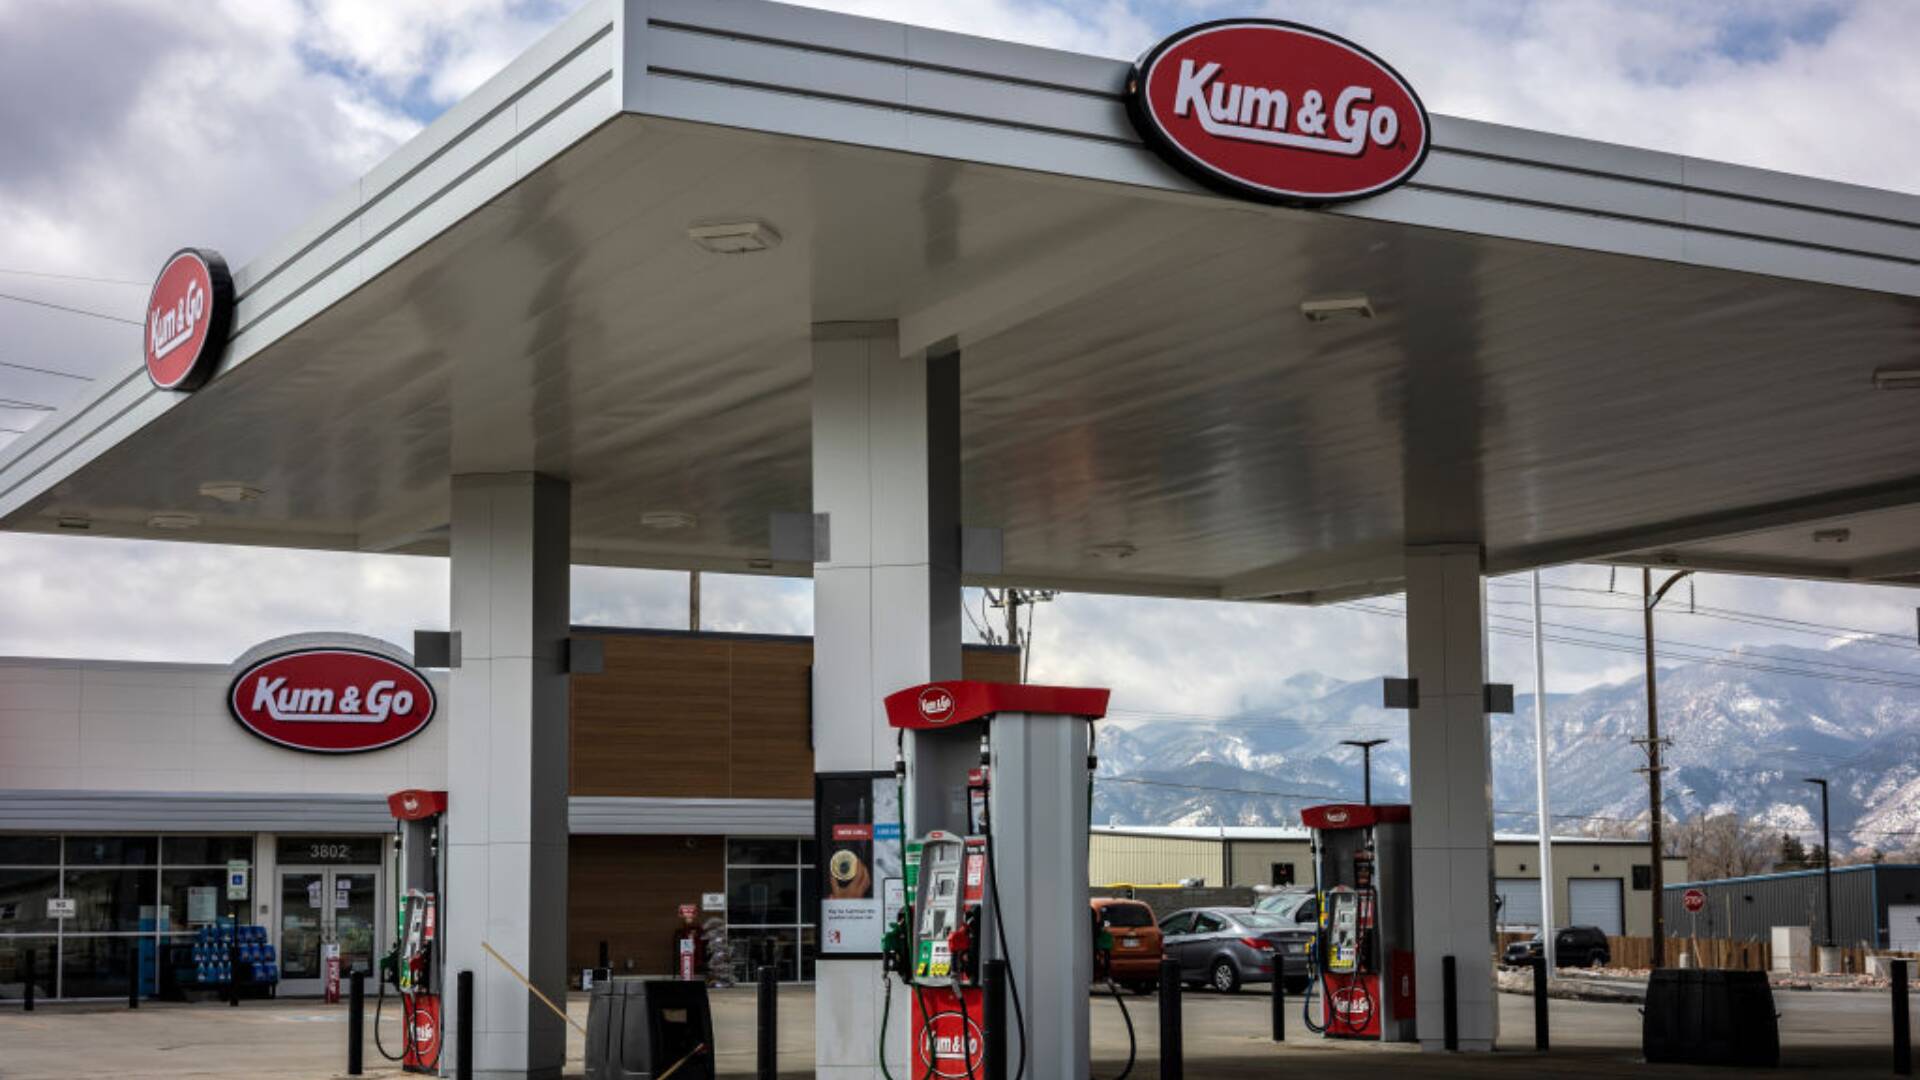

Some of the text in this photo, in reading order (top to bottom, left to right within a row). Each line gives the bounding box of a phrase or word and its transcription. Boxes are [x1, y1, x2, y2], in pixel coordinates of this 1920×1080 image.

[1173, 58, 1398, 155] Kum & Go
[152, 279, 203, 359] Kum & Go
[252, 676, 414, 722] Kum & Go
[310, 844, 348, 858] 3802
[1684, 896, 1702, 905] STOP
[952, 1036, 961, 1052] &
